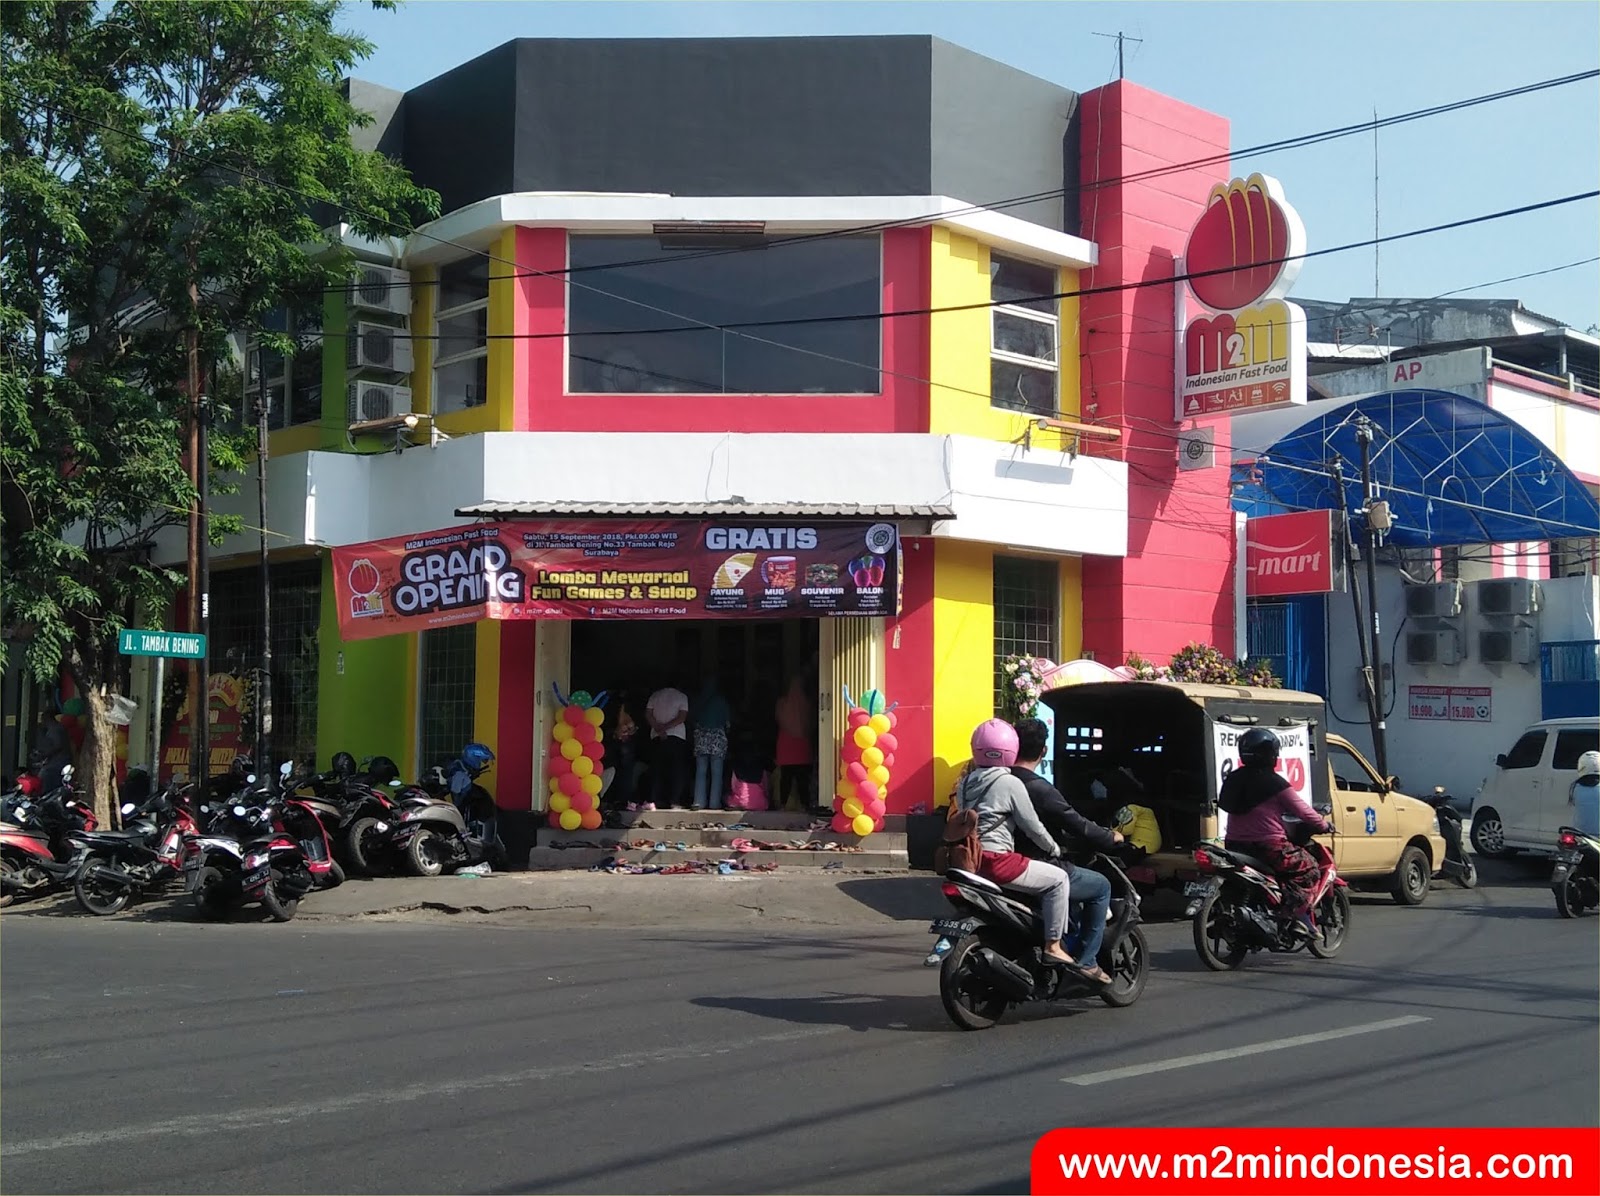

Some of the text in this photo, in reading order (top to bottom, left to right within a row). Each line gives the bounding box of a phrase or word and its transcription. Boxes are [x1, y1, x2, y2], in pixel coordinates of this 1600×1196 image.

[1186, 361, 1288, 388] Indonesian Fast Food
[1394, 361, 1422, 382] AP
[406, 529, 498, 550] M2M Indonesian Fast Food
[560, 533, 600, 541] September
[602, 533, 623, 541] 2018,
[706, 527, 818, 550] GRATIS
[576, 541, 602, 549] Bening
[658, 541, 676, 549] Rejo
[584, 549, 619, 557] Surabaya
[405, 545, 506, 582] GRAND
[540, 571, 689, 584] Lomba Mewarnai
[396, 572, 520, 611] OPENING
[532, 585, 697, 601] Fun Games & Sulap
[710, 588, 744, 596] PAYUNG
[764, 588, 785, 596] MUG
[801, 587, 844, 595] SOUVENIR
[618, 607, 653, 615] Indonesian
[654, 607, 669, 615] Fast
[669, 607, 687, 615] Food
[124, 634, 199, 654] JL. TAMBAK BENING
